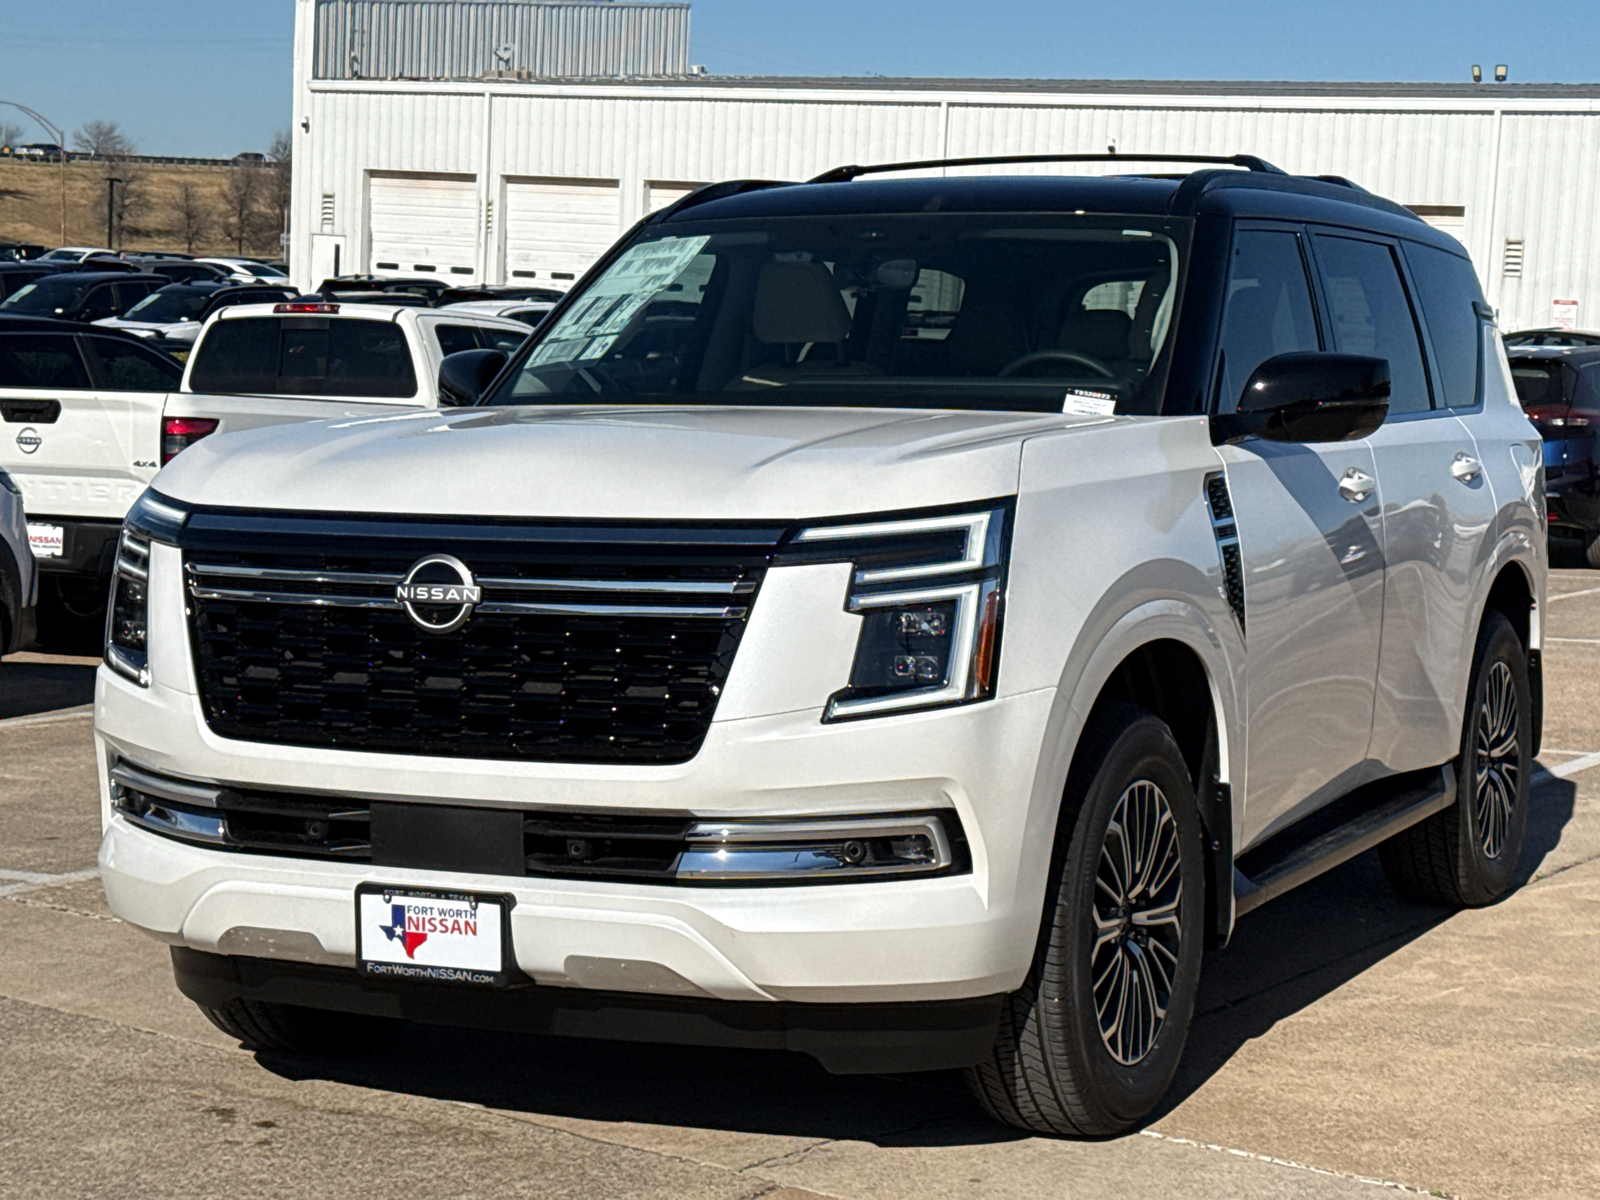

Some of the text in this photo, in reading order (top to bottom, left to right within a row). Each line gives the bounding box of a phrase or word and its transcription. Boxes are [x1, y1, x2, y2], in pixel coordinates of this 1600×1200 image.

[29, 535, 61, 544] NISSAN
[397, 586, 478, 601] NISSAN
[449, 893, 475, 902] TEXAS
[407, 905, 477, 920] FORT WORTH
[407, 916, 477, 936] NISSAN
